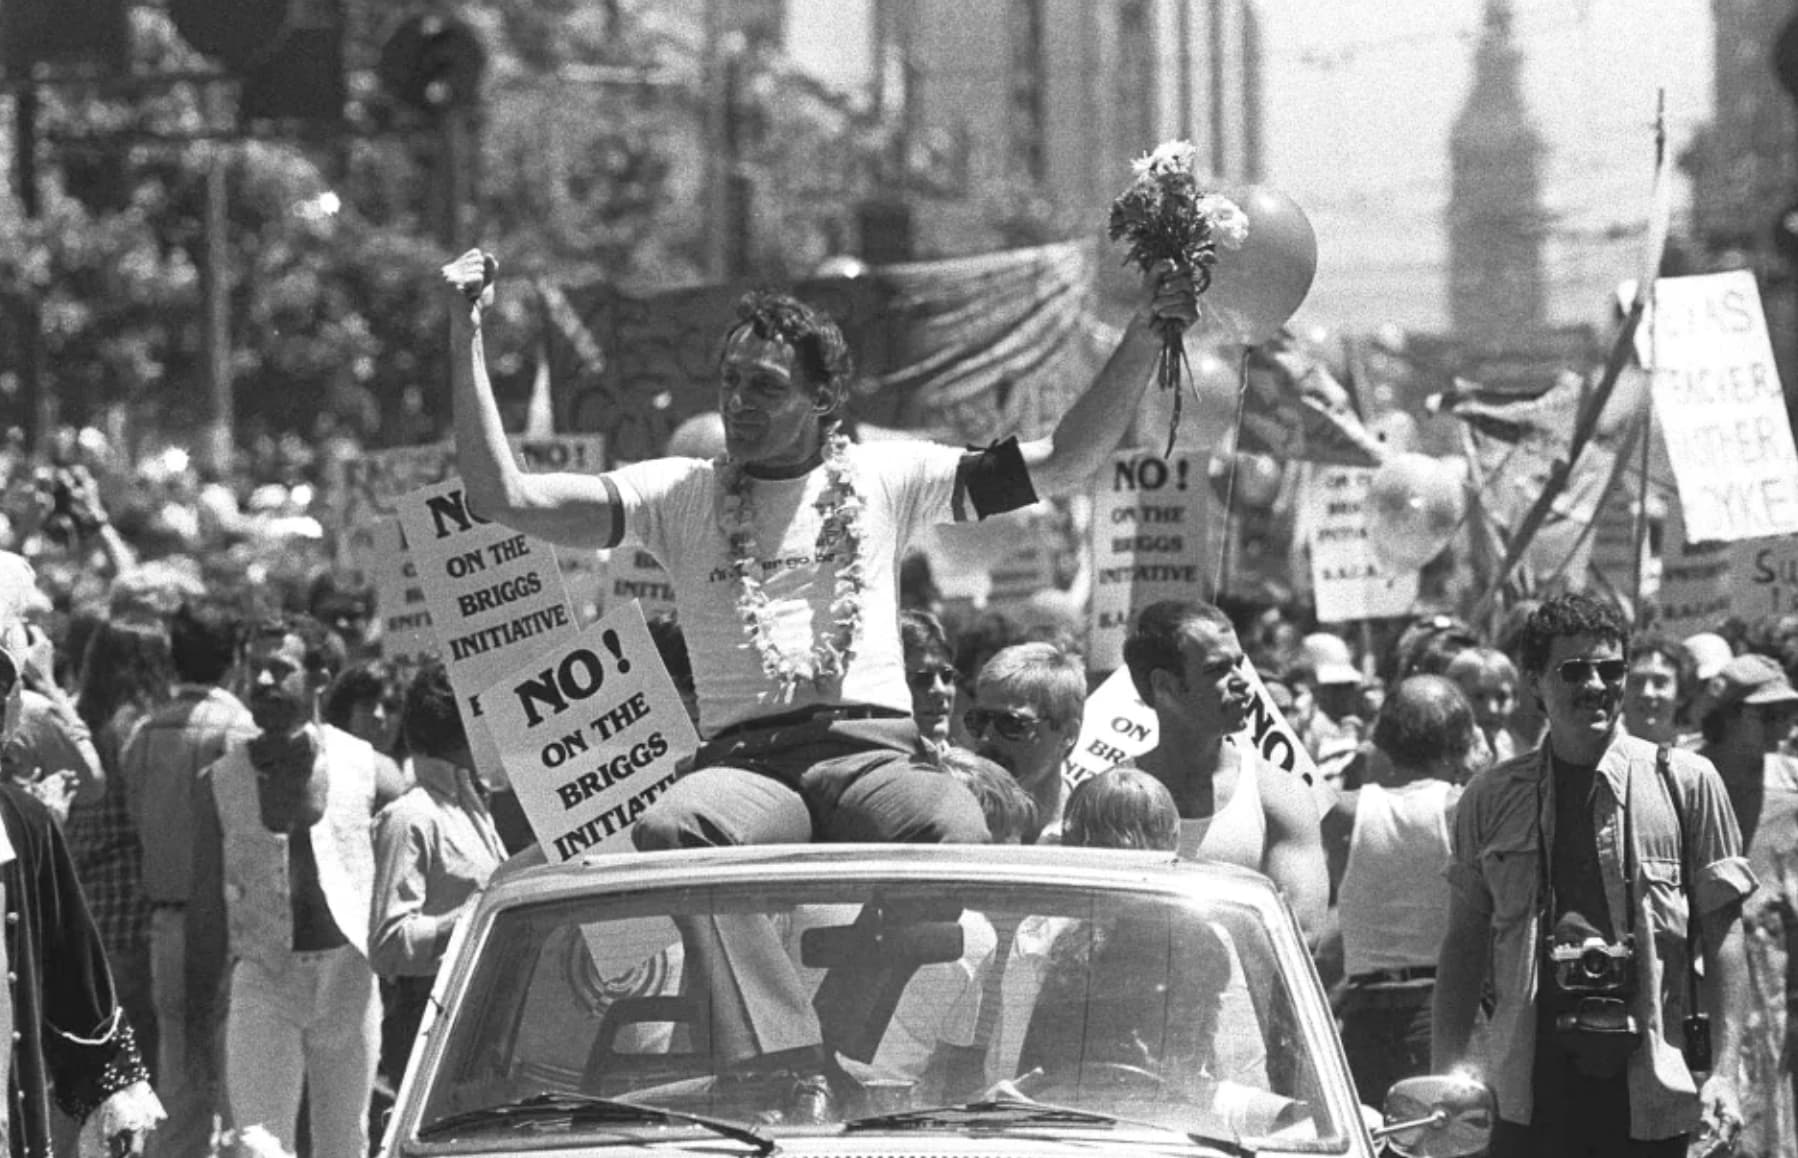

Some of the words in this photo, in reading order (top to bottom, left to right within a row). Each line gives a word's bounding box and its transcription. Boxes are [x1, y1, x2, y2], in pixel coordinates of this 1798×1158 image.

[1113, 458, 1189, 491] NO!
[1111, 507, 1136, 523] ON
[1141, 505, 1186, 522] THE
[446, 549, 486, 579] ON
[488, 533, 531, 567] THE
[1111, 535, 1183, 552] BRIGGS
[457, 572, 543, 618] BRIGGS
[1098, 565, 1198, 584] INITIATIVE
[449, 603, 570, 662] INITIATIVE
[513, 628, 632, 729] NO!
[541, 729, 589, 769] ON
[590, 691, 651, 742] THE
[1110, 716, 1151, 742] ON
[555, 731, 669, 811] BRIGGS
[552, 773, 677, 863] INITIAT
